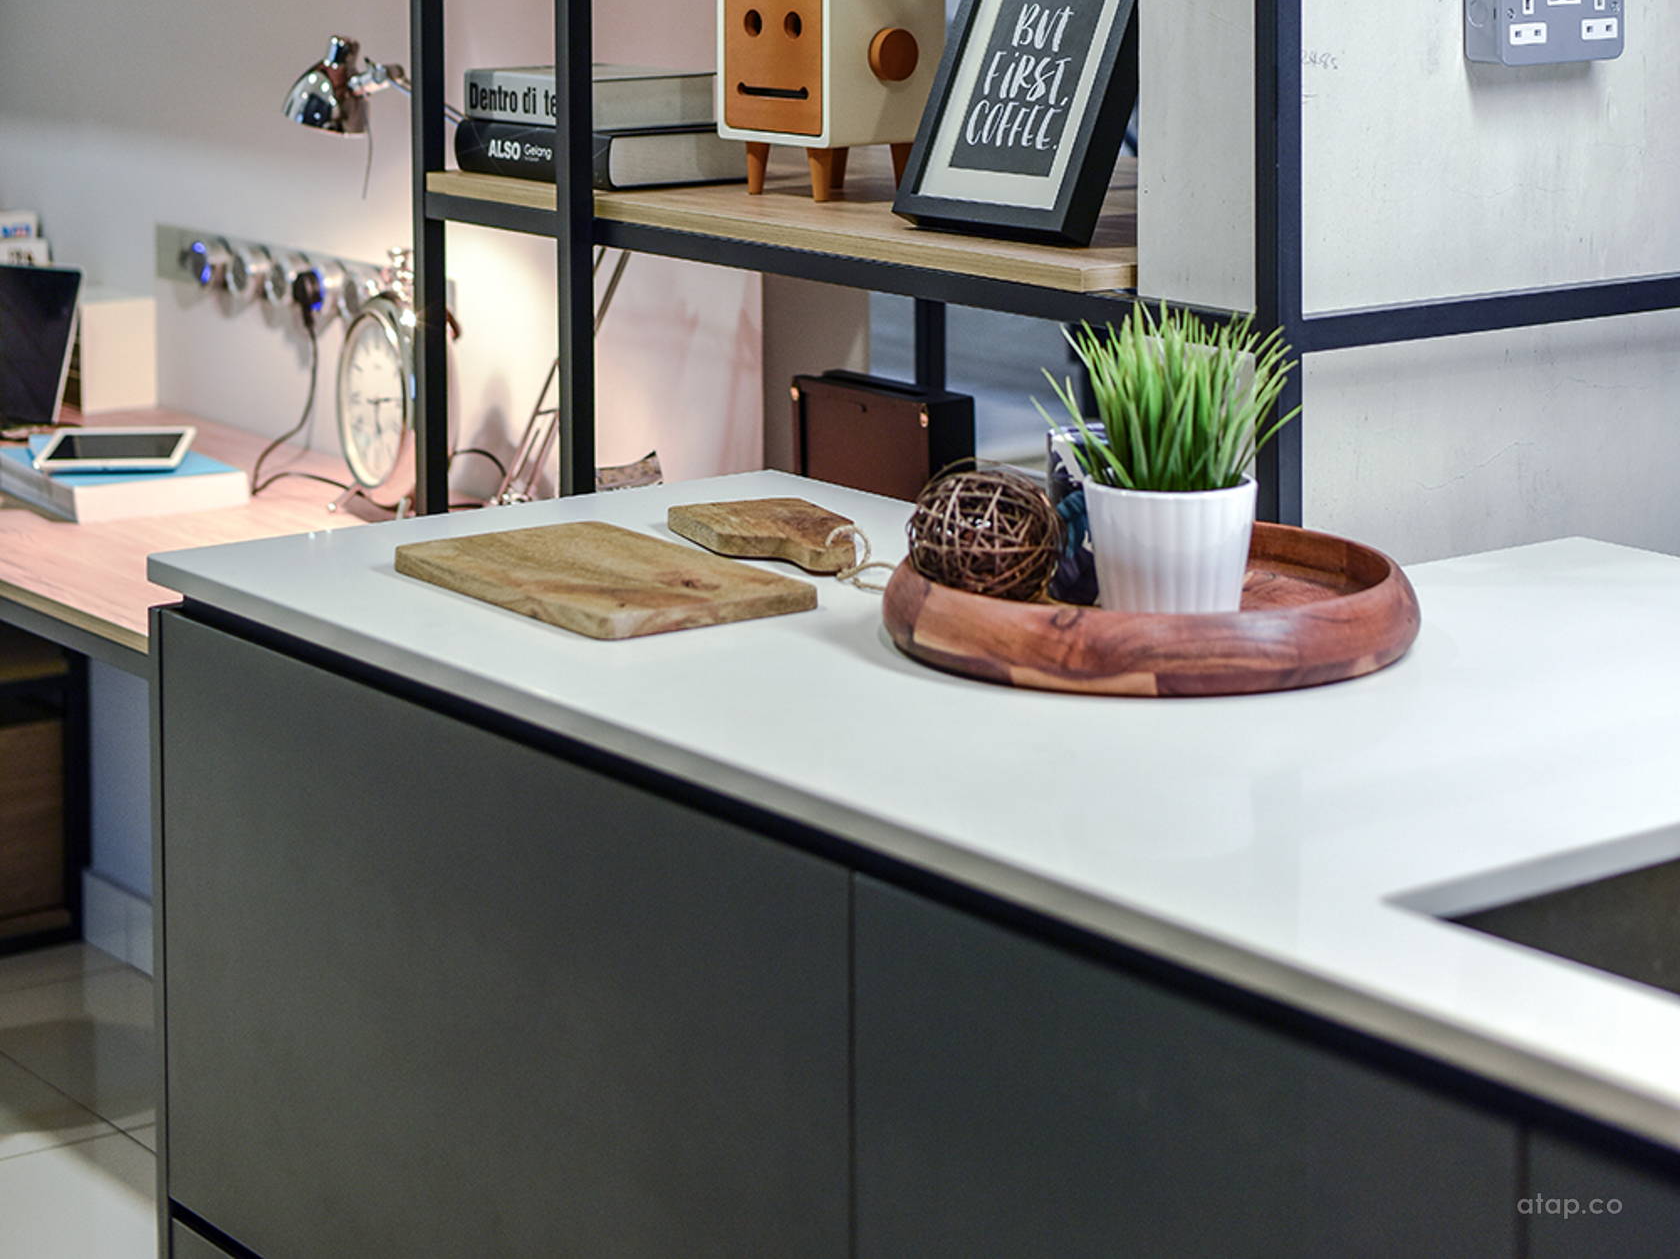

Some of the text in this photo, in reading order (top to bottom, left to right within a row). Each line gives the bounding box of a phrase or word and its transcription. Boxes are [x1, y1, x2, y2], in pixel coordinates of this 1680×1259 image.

[468, 81, 519, 114] Dentro
[522, 86, 537, 116] di
[487, 138, 522, 161] ALSO
